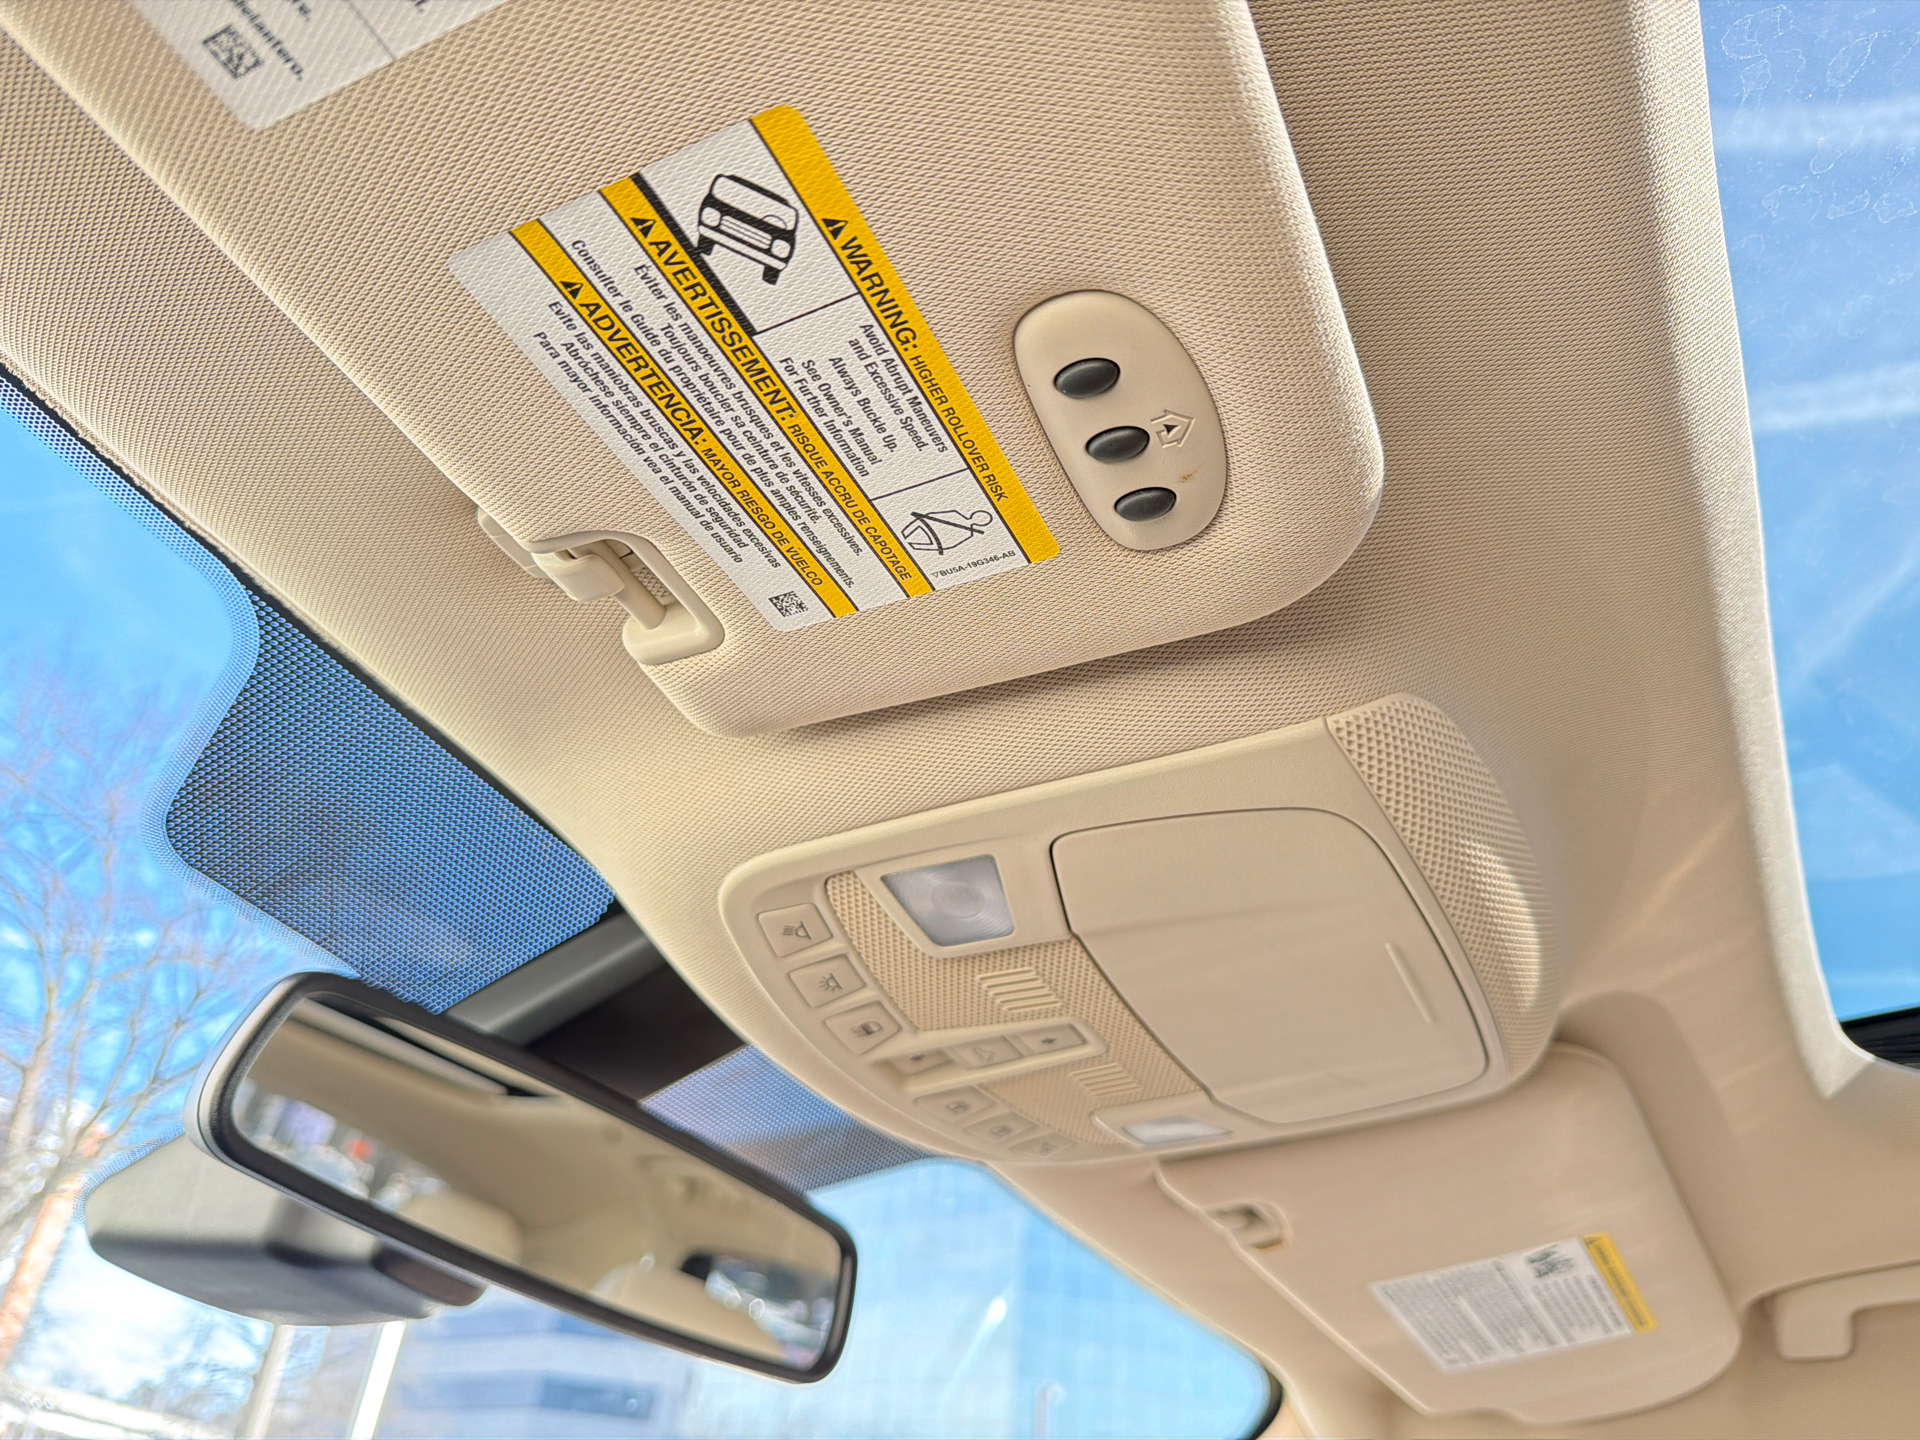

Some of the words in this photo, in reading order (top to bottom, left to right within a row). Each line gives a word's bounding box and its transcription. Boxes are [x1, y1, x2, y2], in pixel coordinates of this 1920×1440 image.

[532, 331, 561, 359] Para
[556, 359, 593, 393] mayor
[588, 394, 646, 456] información
[642, 455, 663, 474] vea
[658, 475, 675, 485] el
[668, 485, 706, 519] manual
[699, 519, 714, 531] de
[710, 531, 743, 563] usuario
[547, 300, 577, 331] Evite
[573, 331, 594, 351] las
[590, 351, 643, 408] maniobras
[638, 408, 679, 450] bruscas
[671, 450, 687, 458] y
[681, 458, 700, 474] las
[696, 474, 746, 527] velocidades
[741, 527, 781, 568] excesivas
[560, 341, 615, 398] Abróchese
[611, 399, 652, 441] siempre
[648, 441, 665, 453] el
[658, 453, 698, 493] cinturón
[693, 493, 709, 506] de
[704, 506, 750, 549] seguridad
[570, 239, 624, 298] Consulter
[617, 299, 634, 313] le
[629, 313, 662, 347] Guide
[657, 346, 676, 364] du
[667, 364, 726, 427] propriétaire
[718, 427, 747, 451] pour
[740, 452, 757, 466] de
[749, 466, 775, 488] plus
[769, 488, 802, 521] amples
[796, 521, 854, 588] renseignements.
[578, 302, 707, 445] ADVERTENCIA:
[700, 447, 742, 489] MAYOR
[735, 489, 776, 529] RIESGO
[770, 530, 790, 546] DE
[785, 545, 823, 588] VUELCO
[632, 263, 668, 300] Éviter
[662, 301, 683, 322] les
[677, 321, 736, 390] manoeuvres
[730, 390, 774, 440] brusques
[769, 440, 786, 452] et
[778, 451, 796, 468] les
[791, 468, 827, 507] vitesses
[821, 507, 863, 556] excessives.
[647, 240, 797, 421] AVERTISSEMENT:
[786, 423, 828, 469] RISQUE
[820, 470, 858, 508] ACCRU
[851, 509, 871, 525] DE
[864, 526, 912, 580] CAPOTAGE
[659, 322, 703, 373] Toujours
[697, 372, 736, 413] boucler
[730, 414, 746, 429] sa
[741, 429, 779, 470] ceinture
[774, 470, 790, 484] de
[785, 484, 822, 524] sécurité.
[778, 356, 800, 376] For
[793, 377, 829, 418] Further
[822, 418, 870, 477] Information
[800, 359, 822, 382] See
[817, 382, 853, 427] Owner's
[847, 426, 883, 465] Manual
[827, 356, 862, 397] Always
[855, 396, 887, 434] Buckle
[881, 433, 898, 453] Up.
[839, 235, 918, 352] WARNING:
[909, 354, 949, 406] HIGHER
[940, 406, 990, 473] ROLLOVER
[982, 473, 1008, 502] RISK
[847, 338, 872, 361] and
[863, 360, 905, 416] Excessive
[899, 415, 929, 452] Speed.
[858, 323, 890, 356] Avoid
[880, 357, 914, 396] Abrupt
[905, 395, 948, 453] Maneuvers
